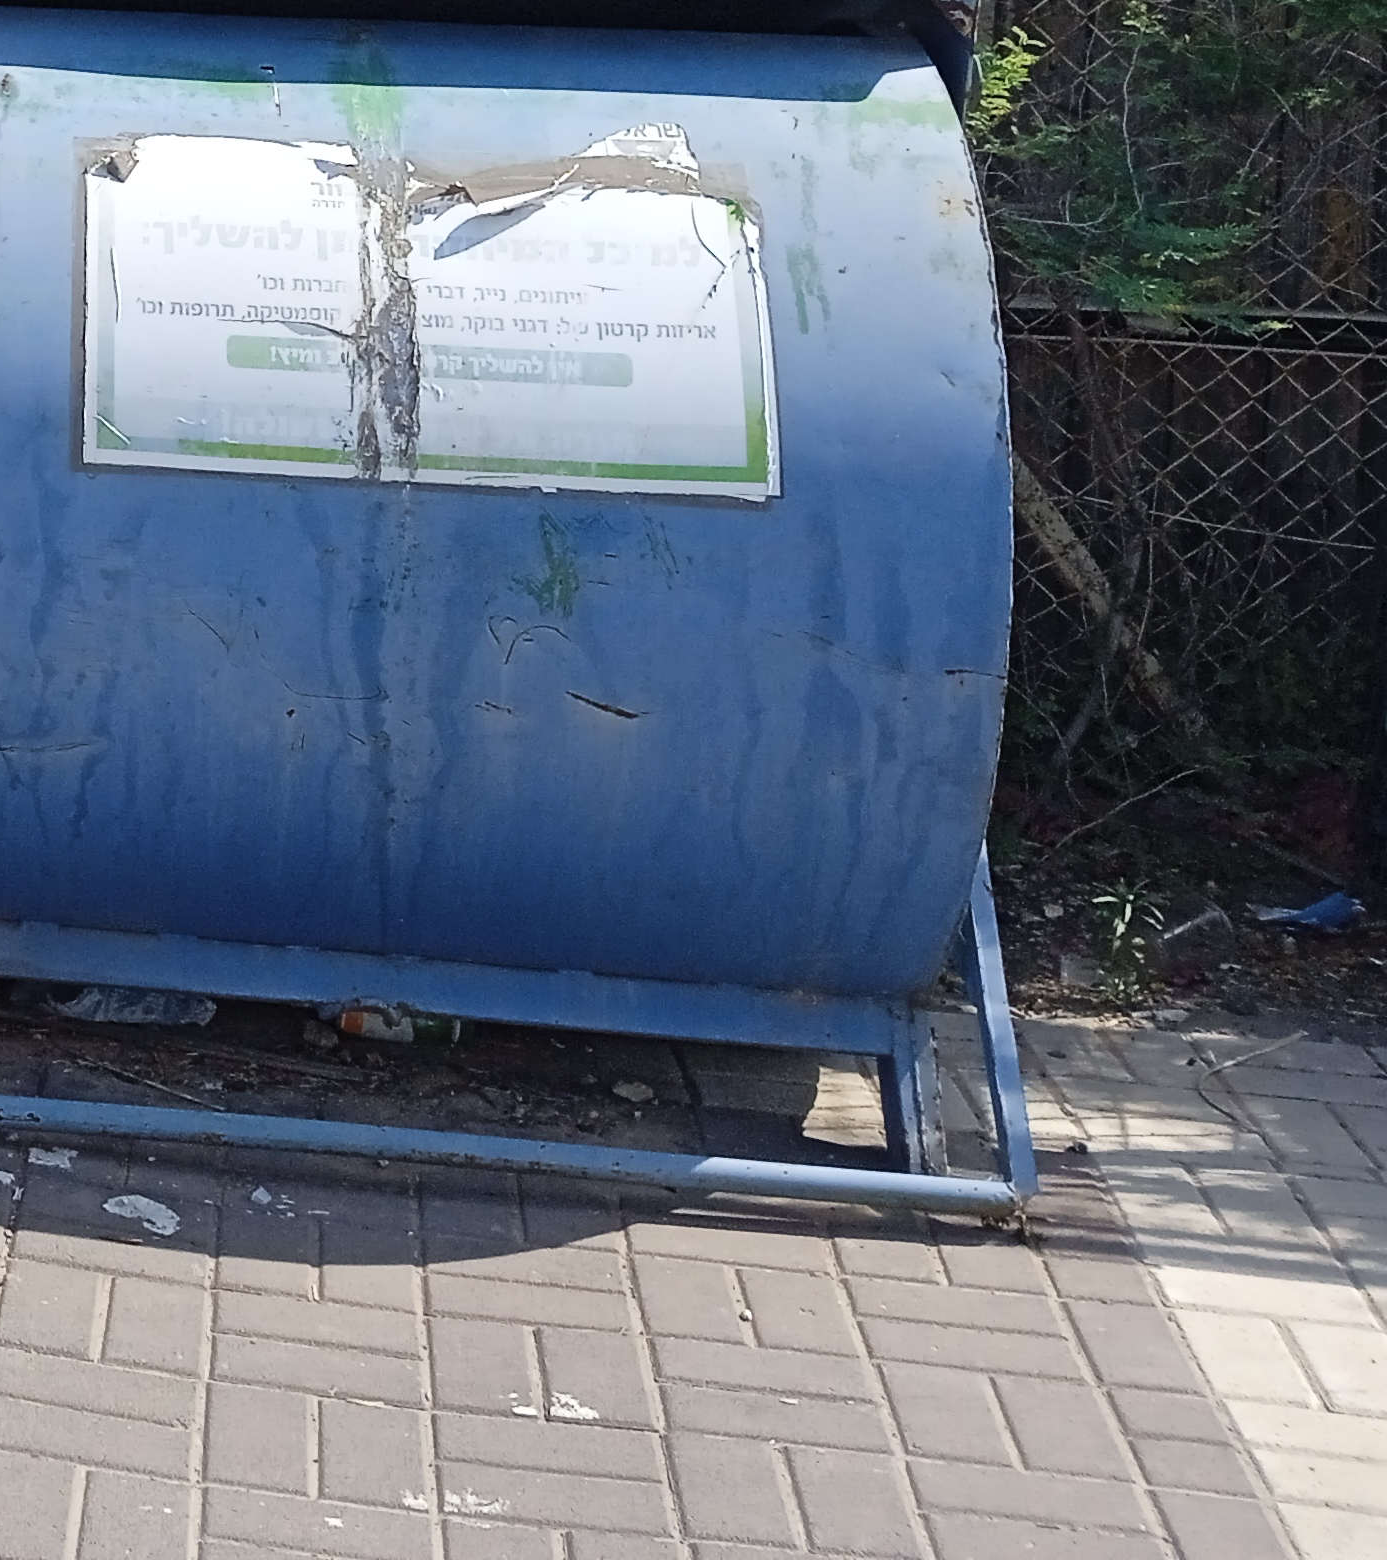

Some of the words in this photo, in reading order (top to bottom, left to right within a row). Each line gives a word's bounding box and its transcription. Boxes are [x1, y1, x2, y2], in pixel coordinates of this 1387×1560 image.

[169, 300, 235, 318] תרופות
[512, 318, 548, 335] דגני
[595, 322, 649, 342] קרטון
[656, 324, 716, 340] אריזות
